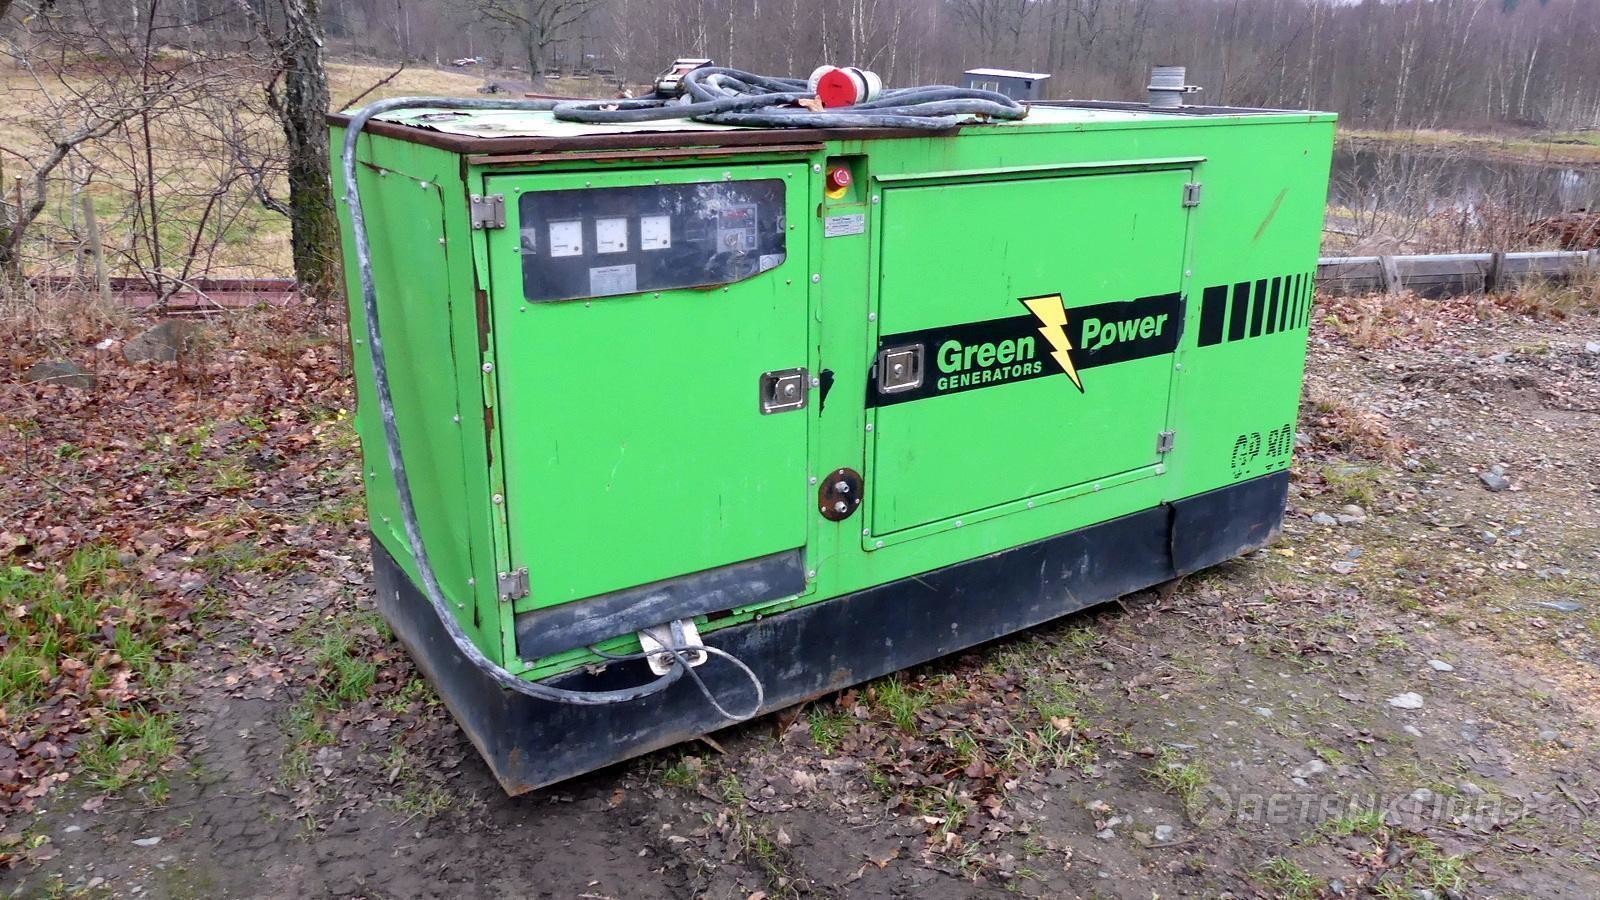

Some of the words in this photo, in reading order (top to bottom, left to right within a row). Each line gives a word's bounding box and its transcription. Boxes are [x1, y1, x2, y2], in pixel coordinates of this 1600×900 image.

[937, 336, 1035, 374] Green
[1081, 314, 1168, 349] Power
[937, 361, 1043, 390] GENERATORS
